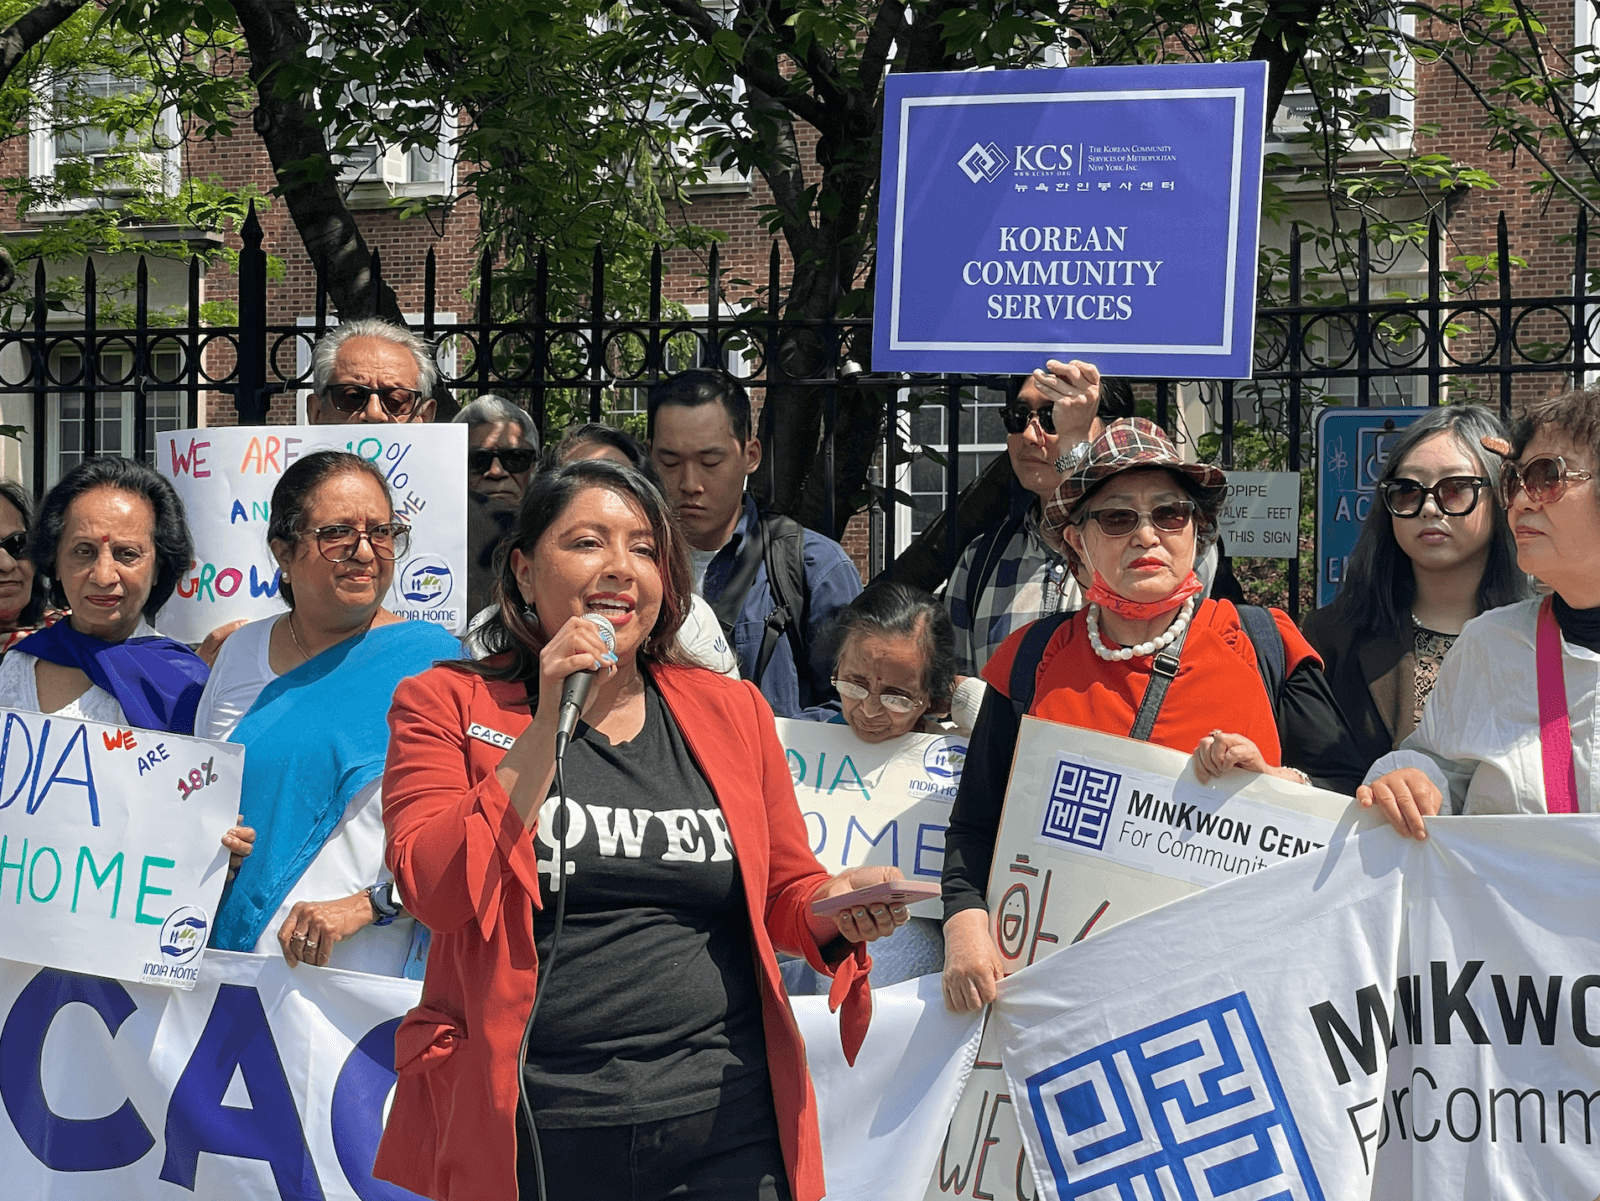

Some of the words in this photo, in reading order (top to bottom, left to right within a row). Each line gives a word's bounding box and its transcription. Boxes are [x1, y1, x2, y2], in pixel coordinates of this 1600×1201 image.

[1013, 144, 1073, 171] KCS
[1103, 145, 1130, 153] KOREAN
[1131, 144, 1171, 152] COMMUNITY
[998, 226, 1128, 252] KOREAN
[962, 260, 1163, 287] COMMUNITY
[987, 294, 1133, 321] SERVICES
[170, 437, 211, 478] WE
[1267, 507, 1292, 519] FEET
[1228, 530, 1255, 542] THIS
[1263, 531, 1291, 543] SIGN
[422, 610, 456, 620] HOME
[471, 725, 514, 746] CACF
[102, 728, 138, 751] WE
[137, 742, 171, 776] ARE
[177, 756, 219, 801] 18%
[909, 780, 938, 793] INDIA
[1119, 820, 1152, 848] For
[0, 835, 176, 926] HOME
[143, 962, 168, 976] INDIA
[169, 966, 198, 981] HOME
